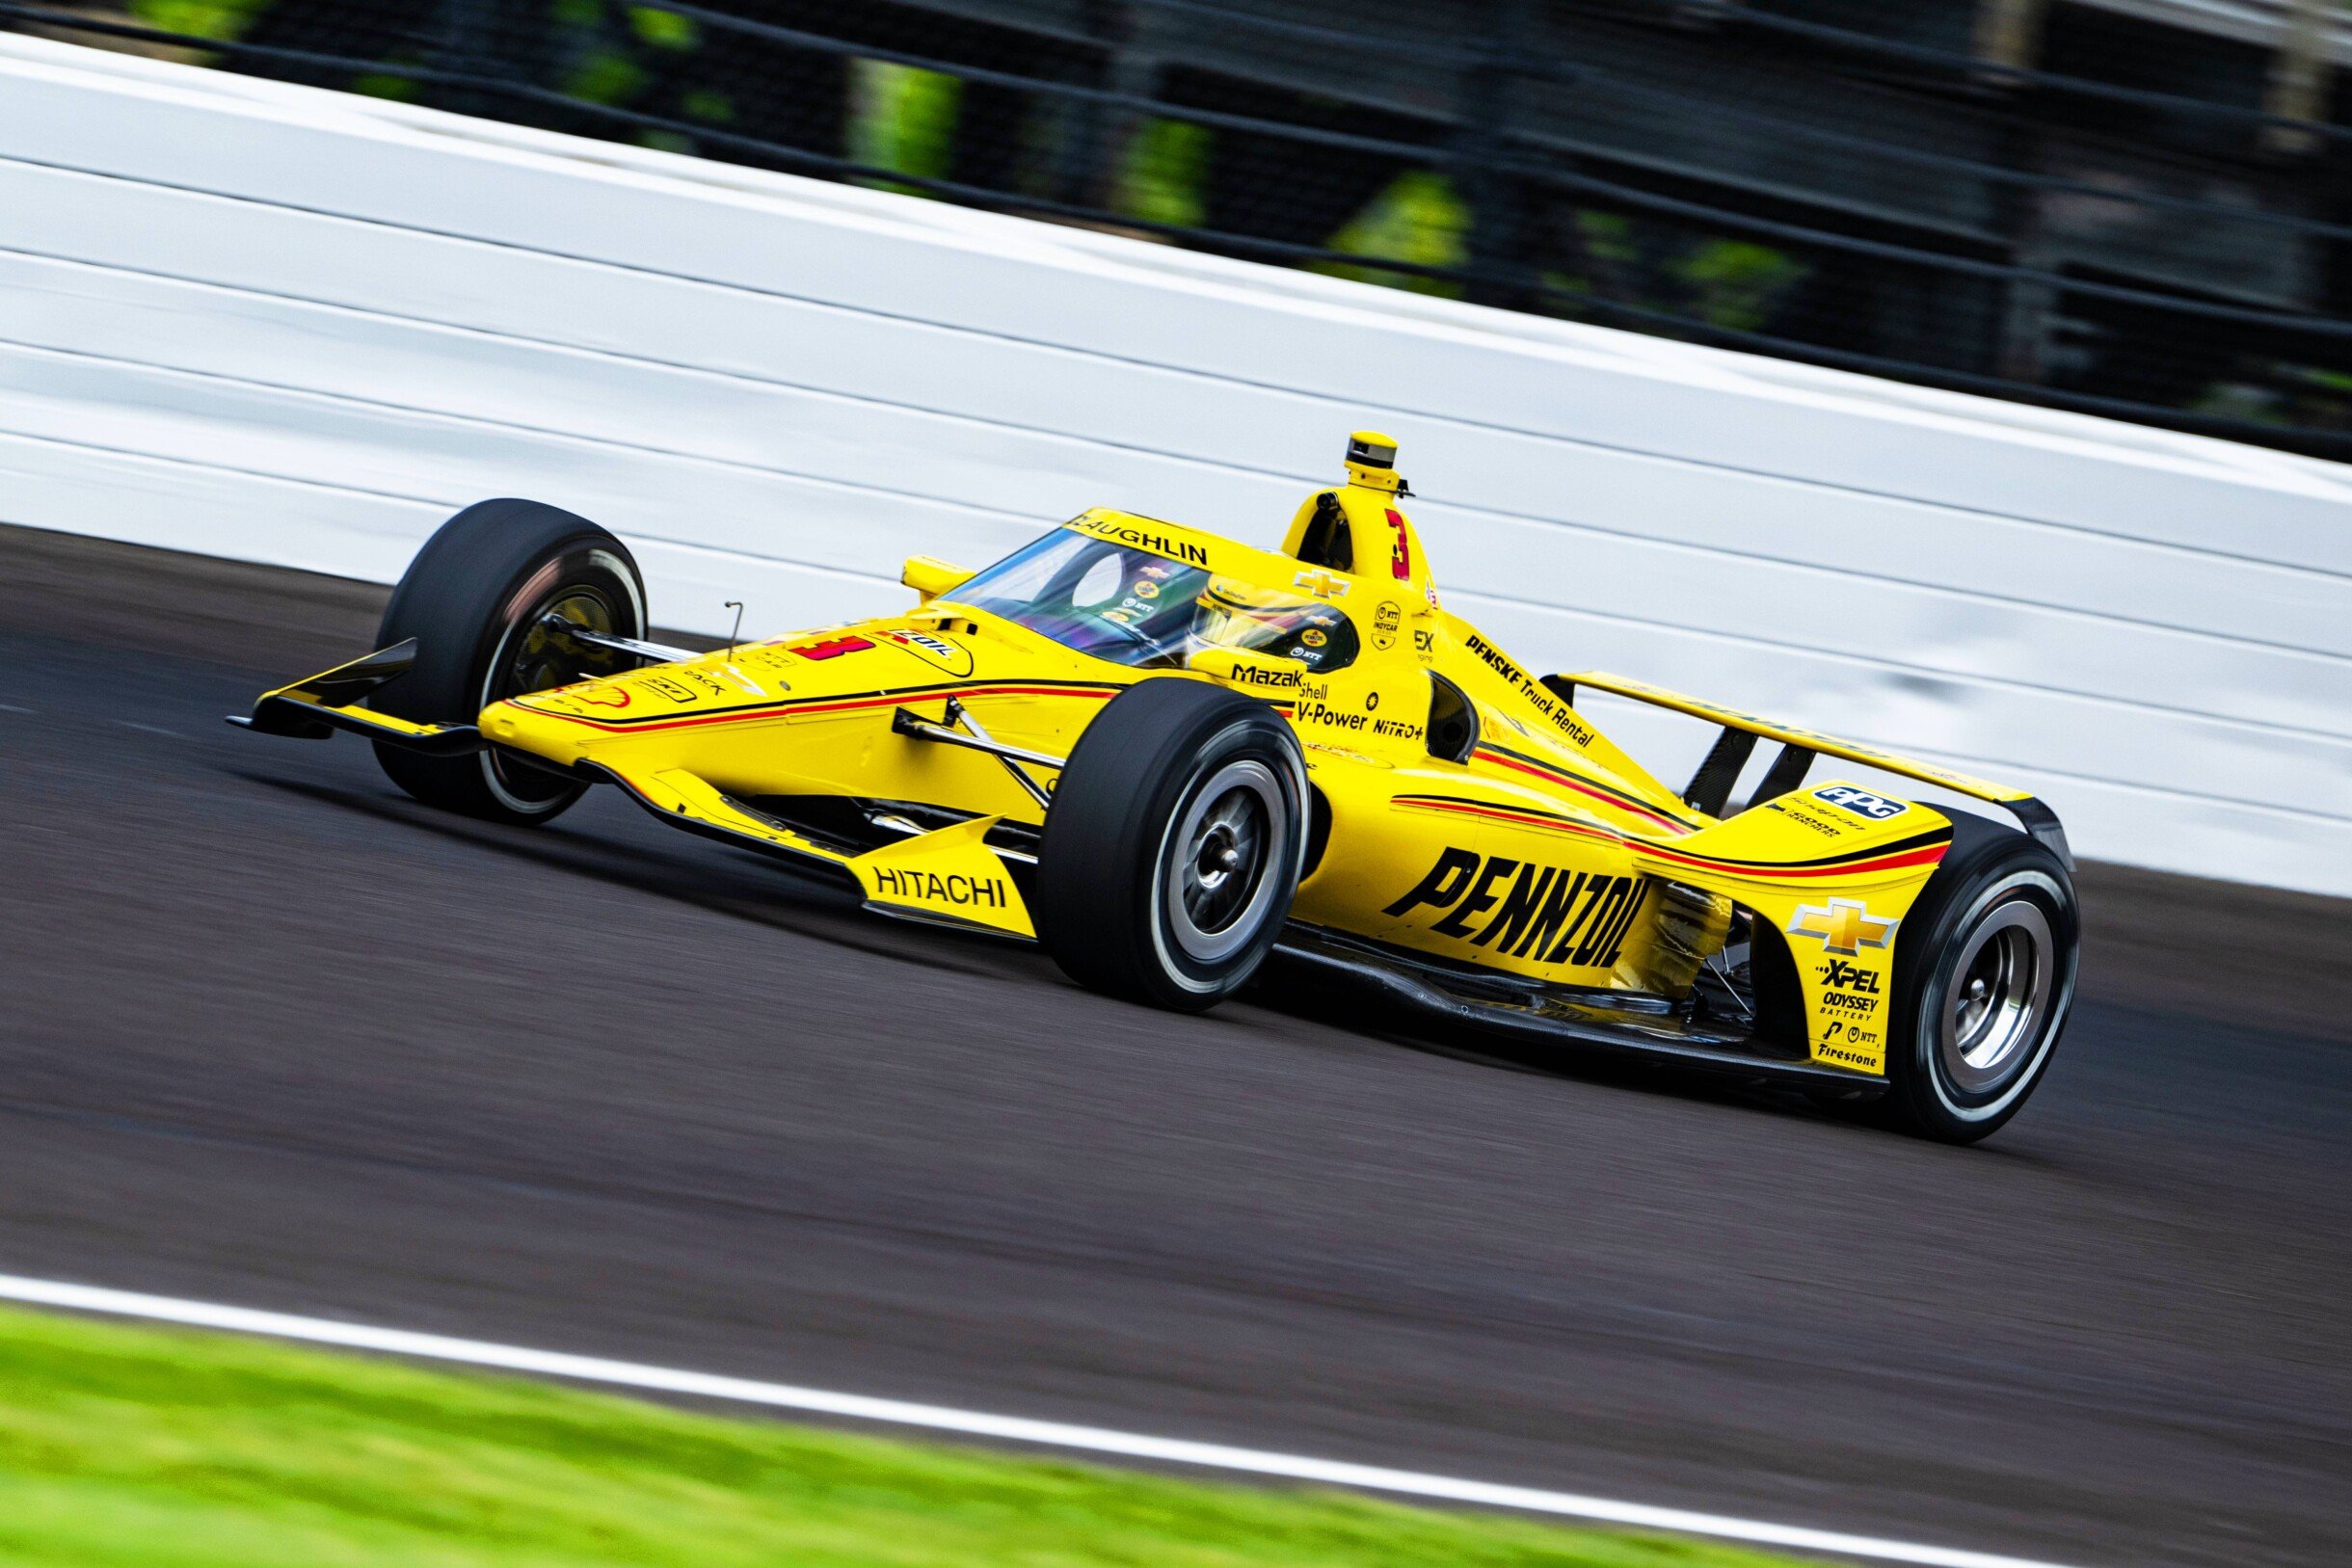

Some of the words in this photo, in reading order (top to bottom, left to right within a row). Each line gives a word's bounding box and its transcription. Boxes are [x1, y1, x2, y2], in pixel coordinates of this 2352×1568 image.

[1384, 508, 1410, 582] 3
[1373, 622, 1398, 632] INDYCAR
[1231, 663, 1305, 688] Mazak
[1298, 682, 1328, 701] Shell
[1465, 634, 1523, 684] PENSKE
[1520, 678, 1554, 715] Truck
[1551, 707, 1595, 748] Rental
[1296, 701, 1368, 731] V-Power
[1821, 786, 1902, 817] PPG
[872, 865, 1006, 908] HITACHI
[1381, 846, 1652, 968] PENNZOIL
[1820, 958, 1881, 994] XPEL
[1819, 1007, 1872, 1021] BATTERY
[1823, 992, 1879, 1013] ODYSSEY
[1860, 1031, 1878, 1044] NTT
[1818, 1043, 1877, 1067] Firestone
